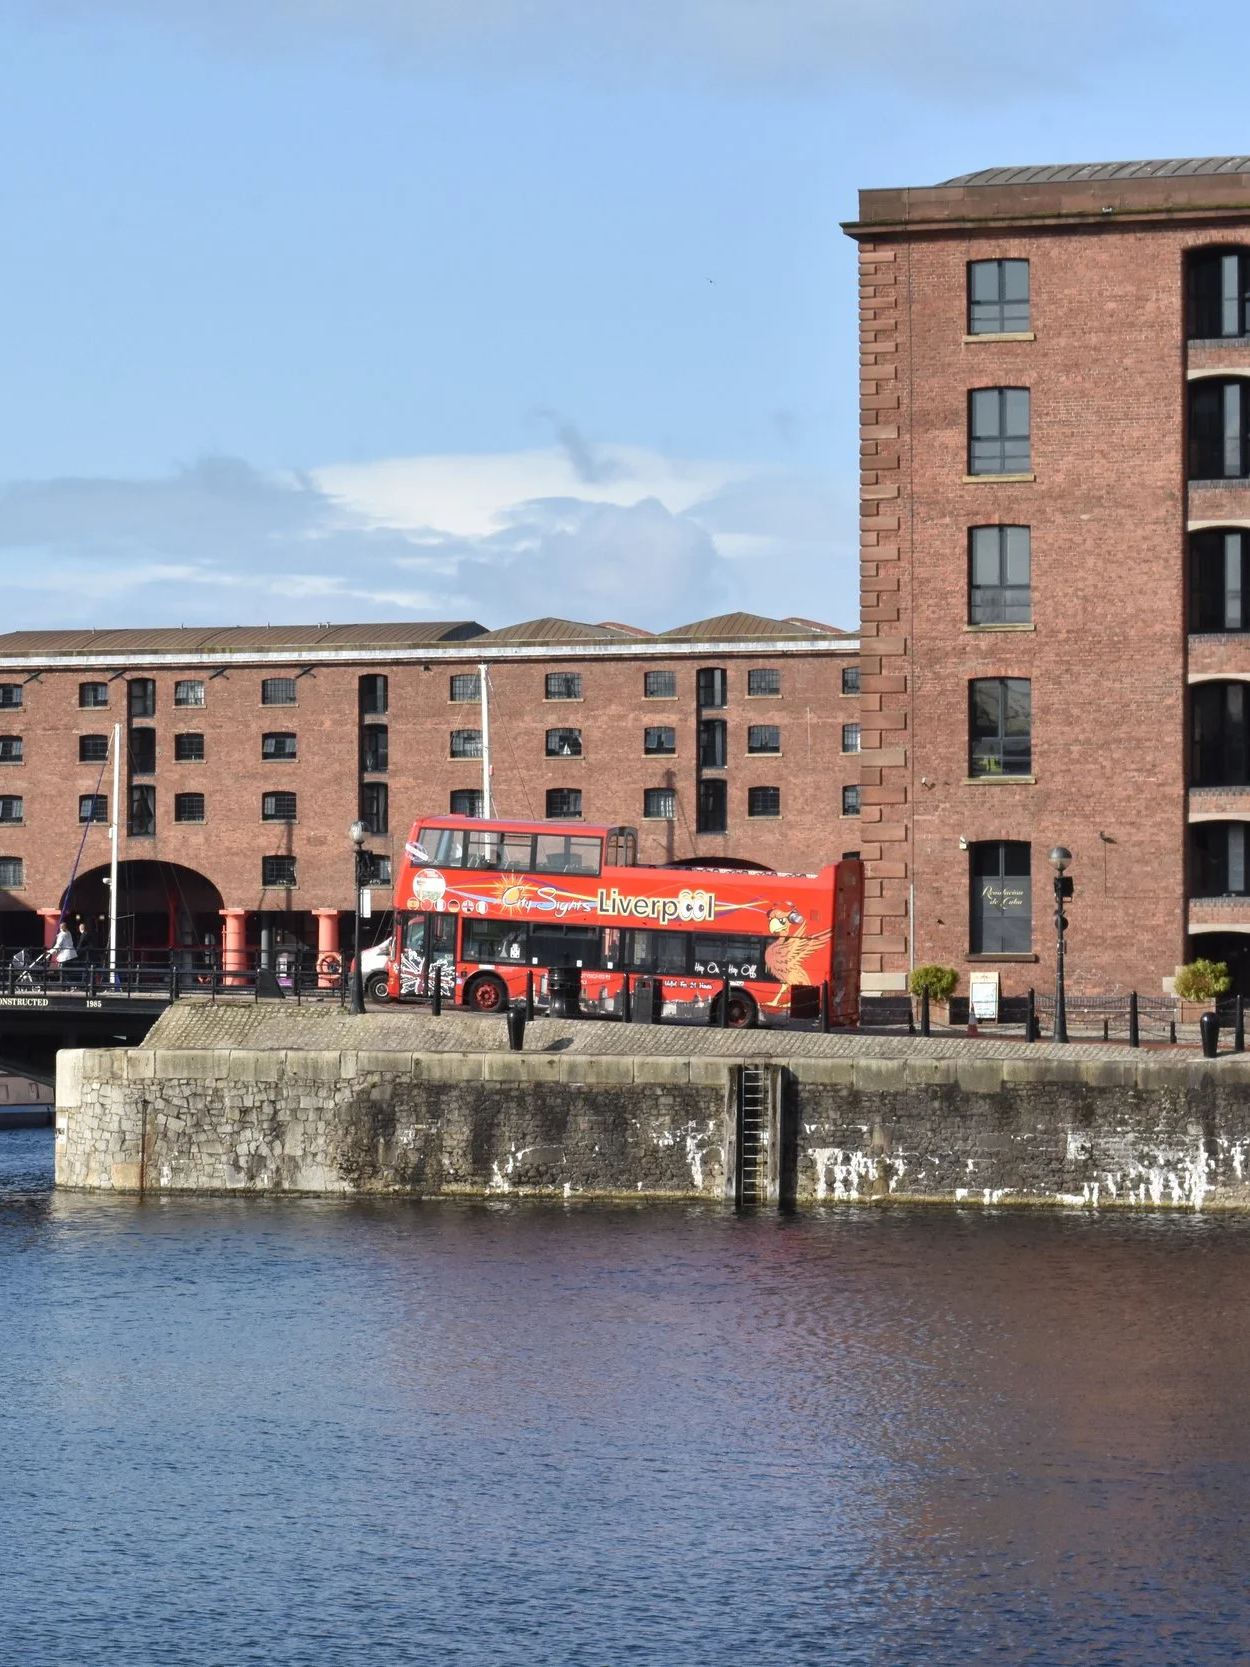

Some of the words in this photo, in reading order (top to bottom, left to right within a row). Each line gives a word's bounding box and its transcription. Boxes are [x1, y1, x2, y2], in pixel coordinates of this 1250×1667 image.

[502, 885, 532, 911] City
[536, 887, 592, 918] Sights
[598, 888, 715, 925] Liverpool
[694, 962, 705, 975] Hop
[707, 962, 720, 974] On
[728, 964, 739, 977] Hop
[741, 964, 757, 979] Off
[86, 1000, 102, 1008] 1985
